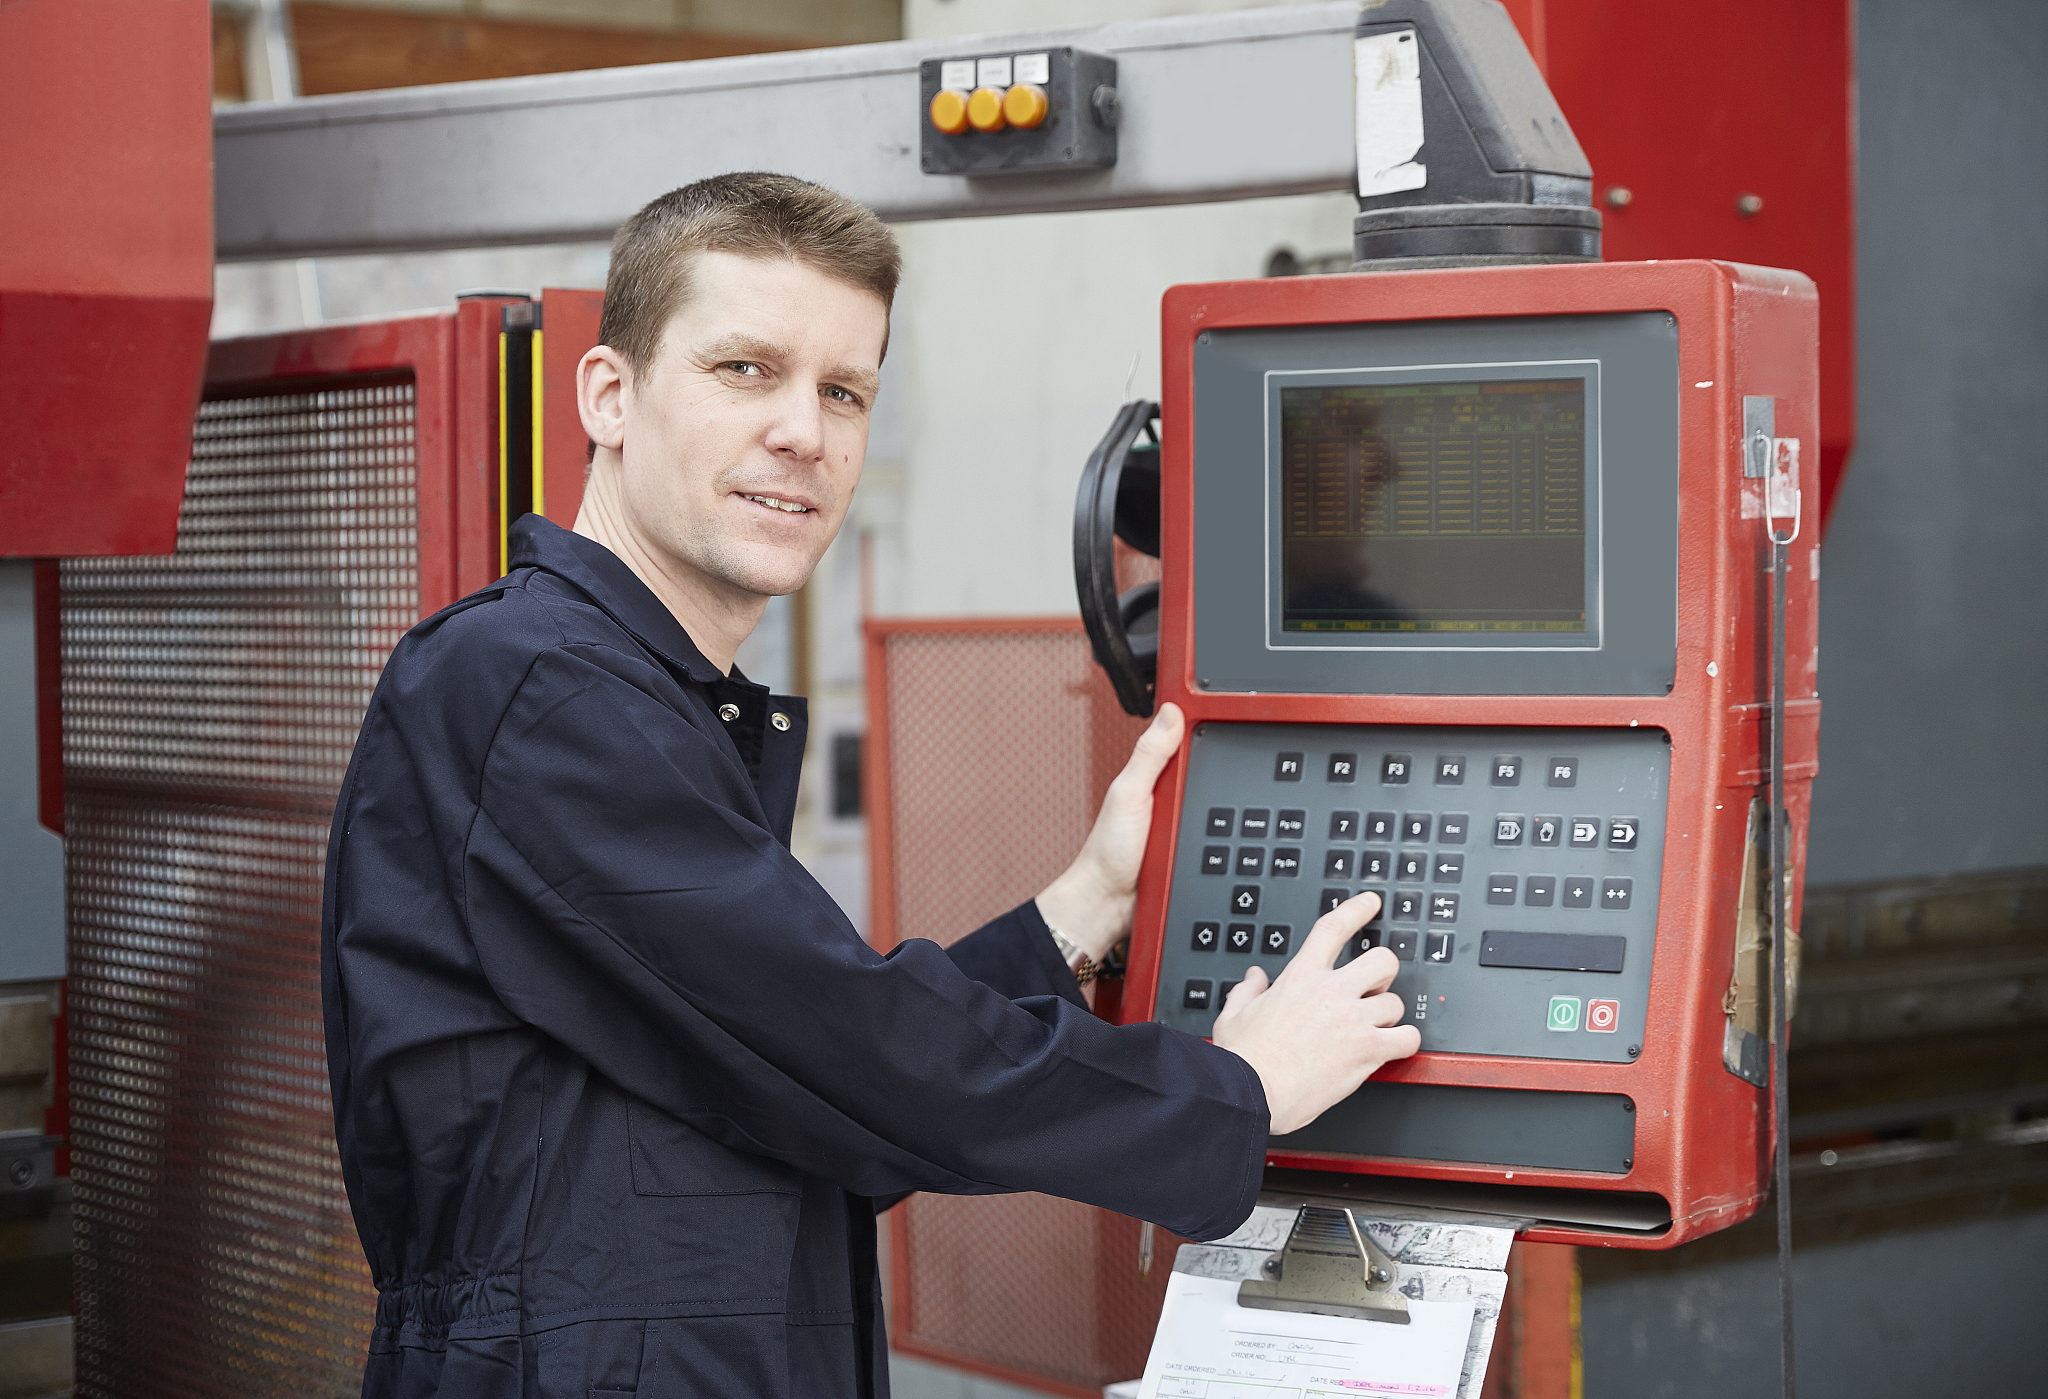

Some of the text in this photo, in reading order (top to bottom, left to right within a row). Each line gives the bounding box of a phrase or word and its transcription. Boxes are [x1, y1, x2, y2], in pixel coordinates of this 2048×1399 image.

[1281, 760, 1297, 773] F1
[1334, 761, 1351, 775] F2
[1387, 762, 1405, 776] F3
[1442, 764, 1459, 777] F4
[1498, 765, 1515, 778] F5
[1554, 766, 1571, 779] F6
[1244, 819, 1267, 829] Home
[1339, 820, 1349, 832] 7
[1375, 821, 1385, 834] 8
[1412, 822, 1422, 835] 9
[1334, 858, 1344, 871] 4
[1370, 859, 1380, 873] 5
[1407, 861, 1417, 874] 6
[1331, 897, 1340, 911] 1
[1402, 900, 1412, 913] 3
[1361, 938, 1372, 951] 0
[1310, 1376, 1328, 1385] DATE
